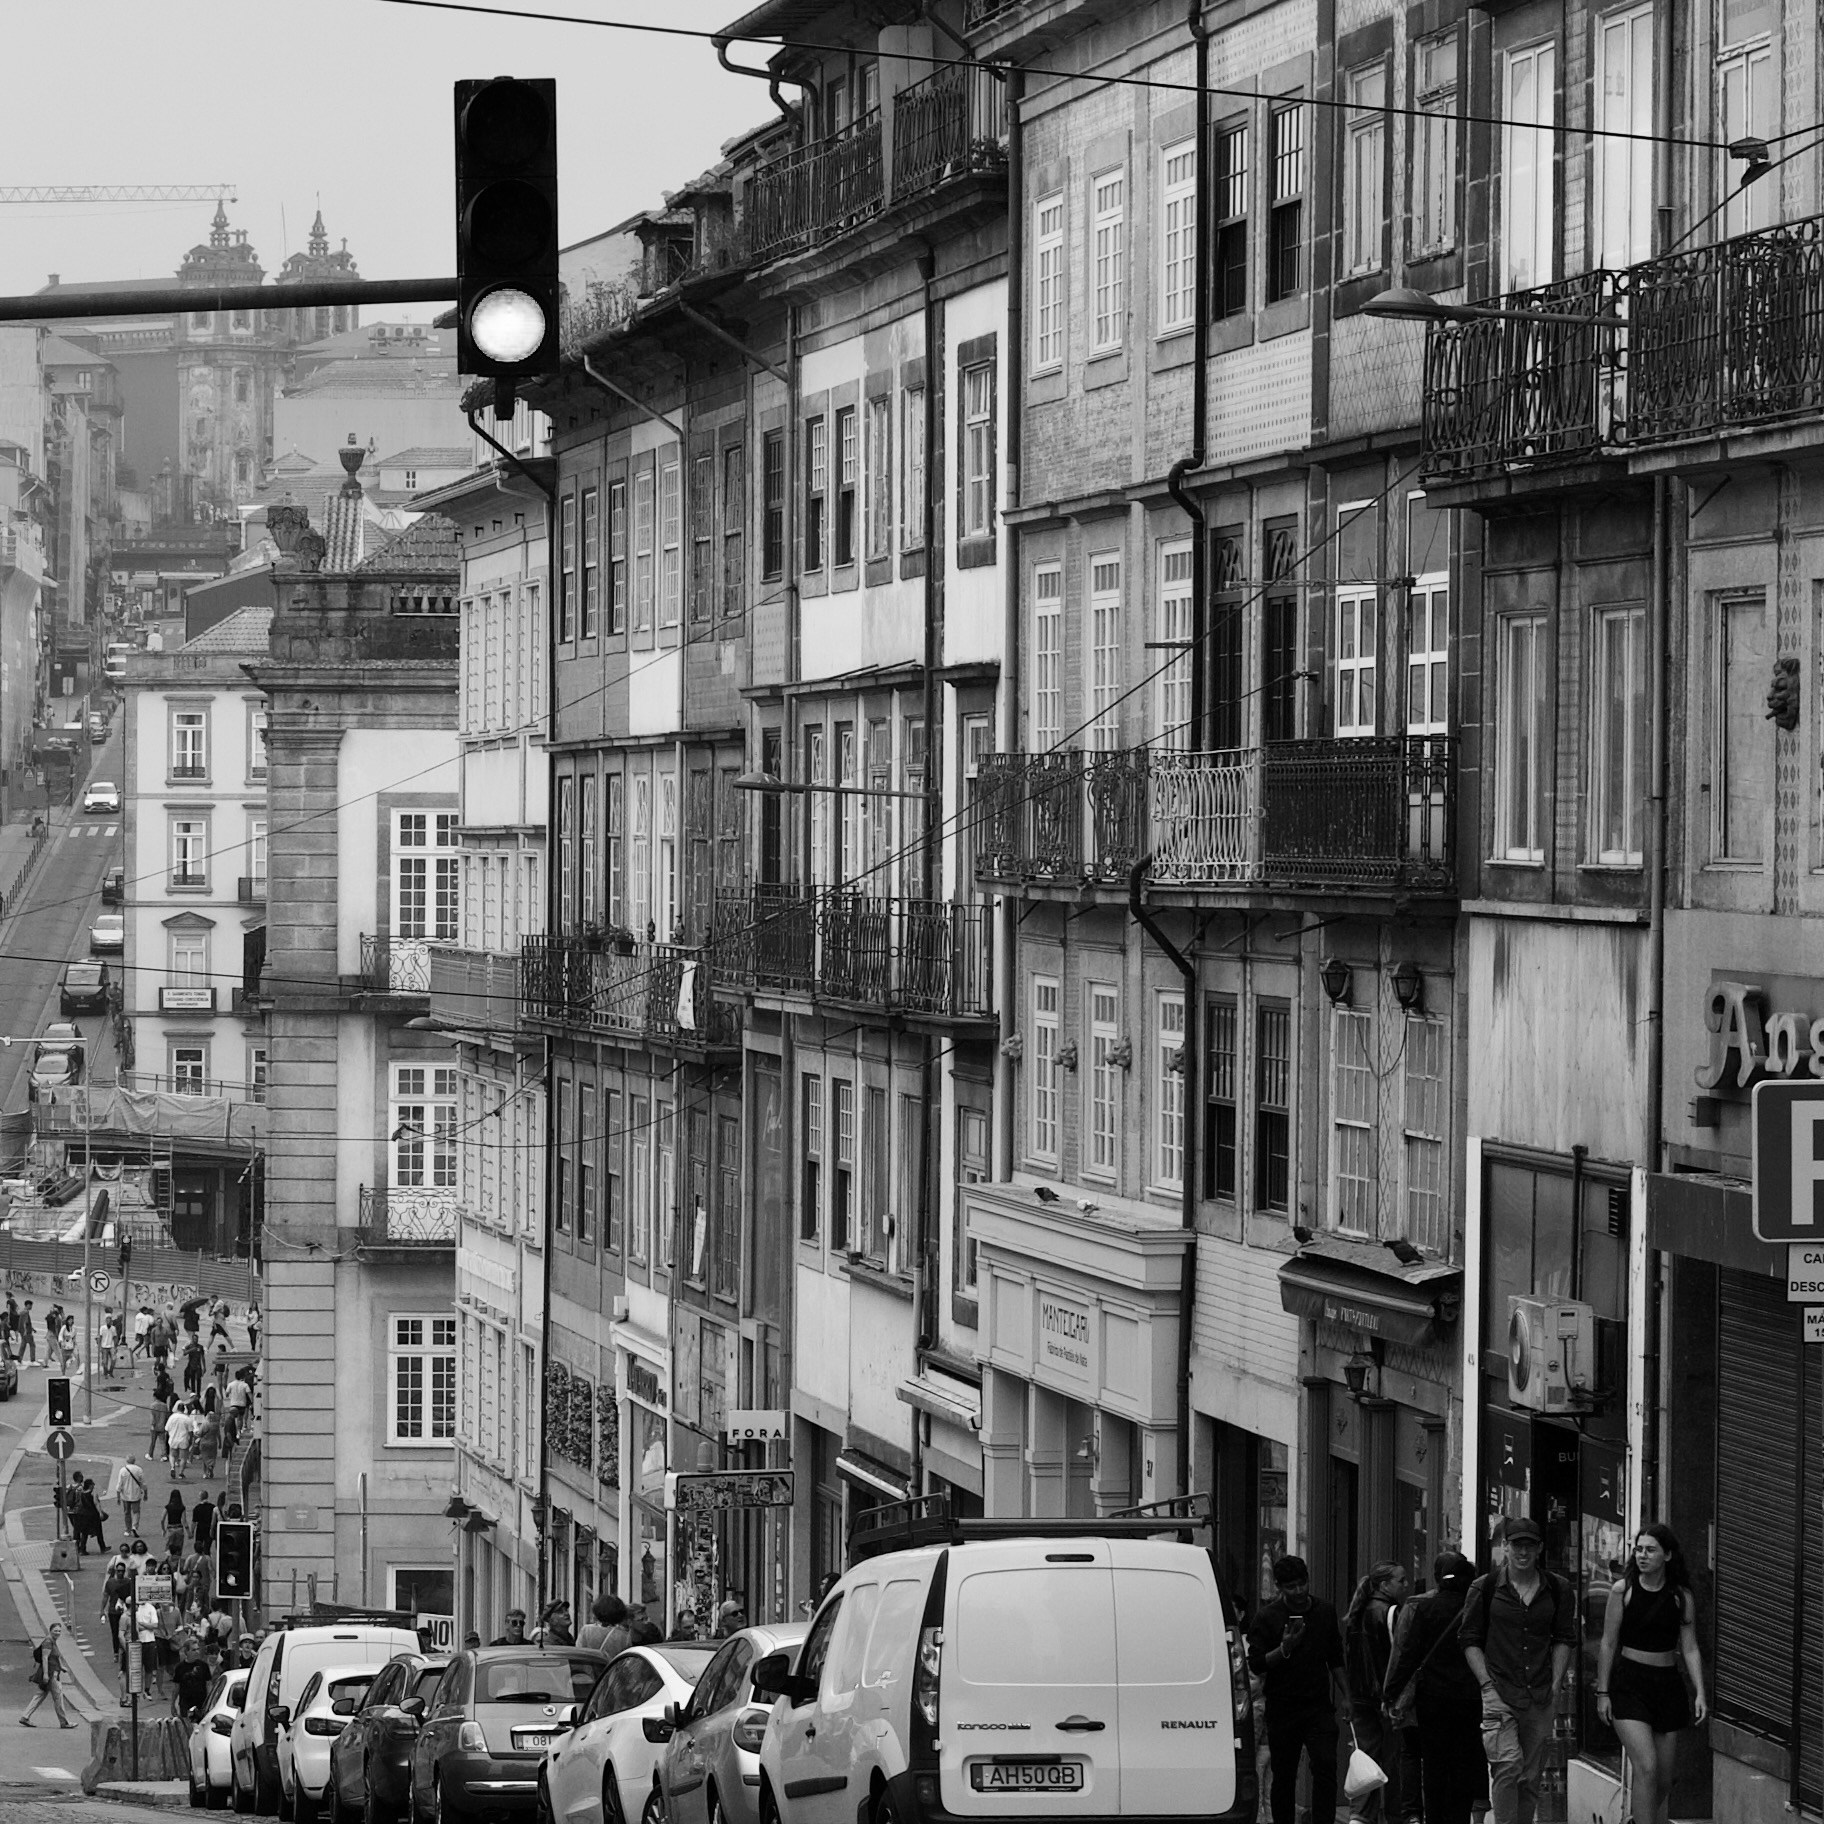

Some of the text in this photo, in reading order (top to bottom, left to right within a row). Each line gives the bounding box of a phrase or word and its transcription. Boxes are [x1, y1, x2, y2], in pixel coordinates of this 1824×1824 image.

[1803, 1253, 1824, 1264] CA
[732, 1428, 782, 1438] FORA
[1160, 1720, 1218, 1729] RENAULT
[990, 1766, 1076, 1785] AH50QB
